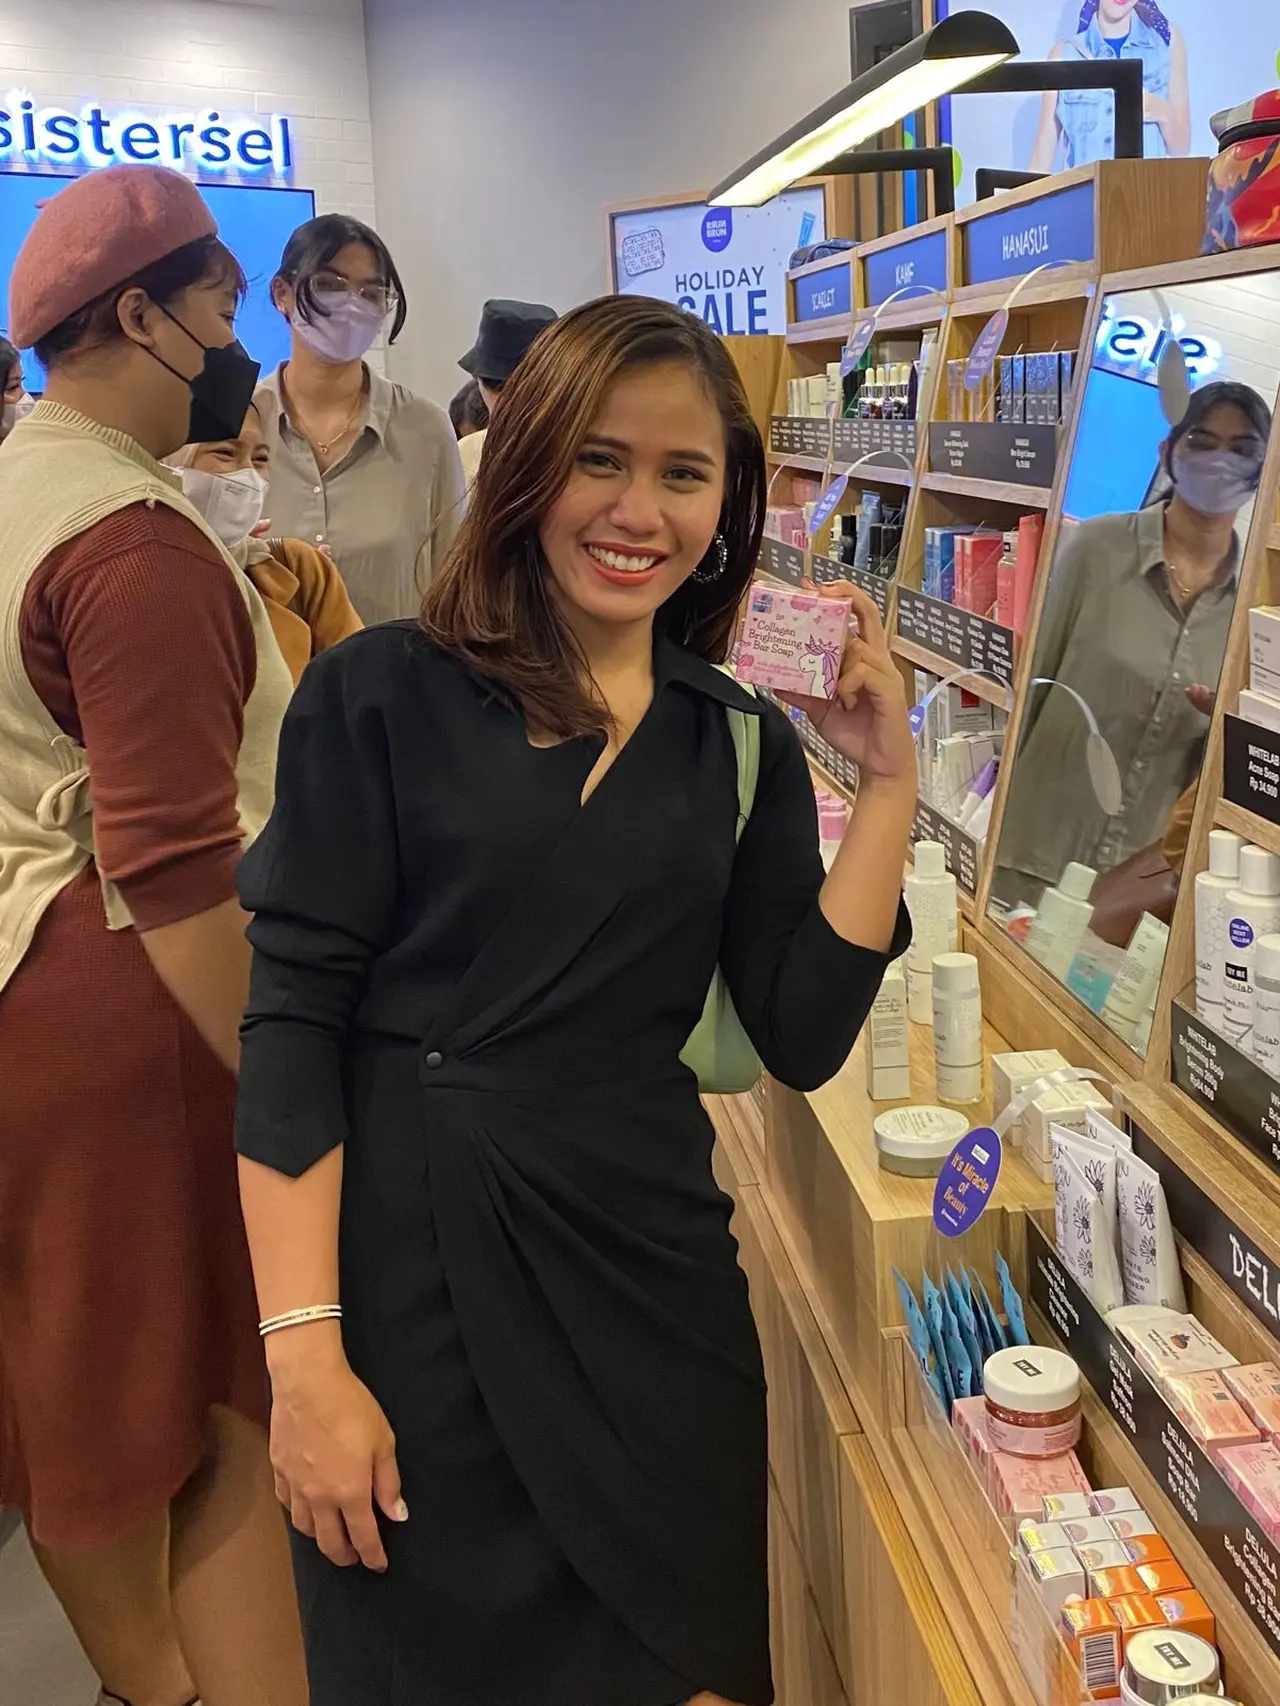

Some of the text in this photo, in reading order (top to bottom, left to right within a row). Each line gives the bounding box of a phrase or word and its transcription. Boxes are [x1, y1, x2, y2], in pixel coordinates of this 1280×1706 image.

[1002, 224, 1049, 261] HANASUI
[675, 265, 764, 293] HOLIDAY
[748, 628, 803, 651] Brightening
[757, 620, 796, 637] Collagen
[753, 640, 794, 659] Bar Soap
[1248, 743, 1280, 767] WHITELAB
[1249, 776, 1259, 791] Rp
[1264, 766, 1280, 784] Soap
[1187, 1025, 1217, 1057] WHITELAB
[1261, 1116, 1276, 1138] Face
[951, 1151, 965, 1172] It's
[962, 1162, 989, 1194] Miracle
[943, 1186, 968, 1216] Beauty
[958, 1181, 970, 1195] of
[1167, 1422, 1195, 1467] DELULA
[1245, 1527, 1278, 1580] DELULA
[1223, 1533, 1267, 1605] Brightening
[1243, 1544, 1277, 1597] Collagen
[1244, 1581, 1257, 1606] Rp
